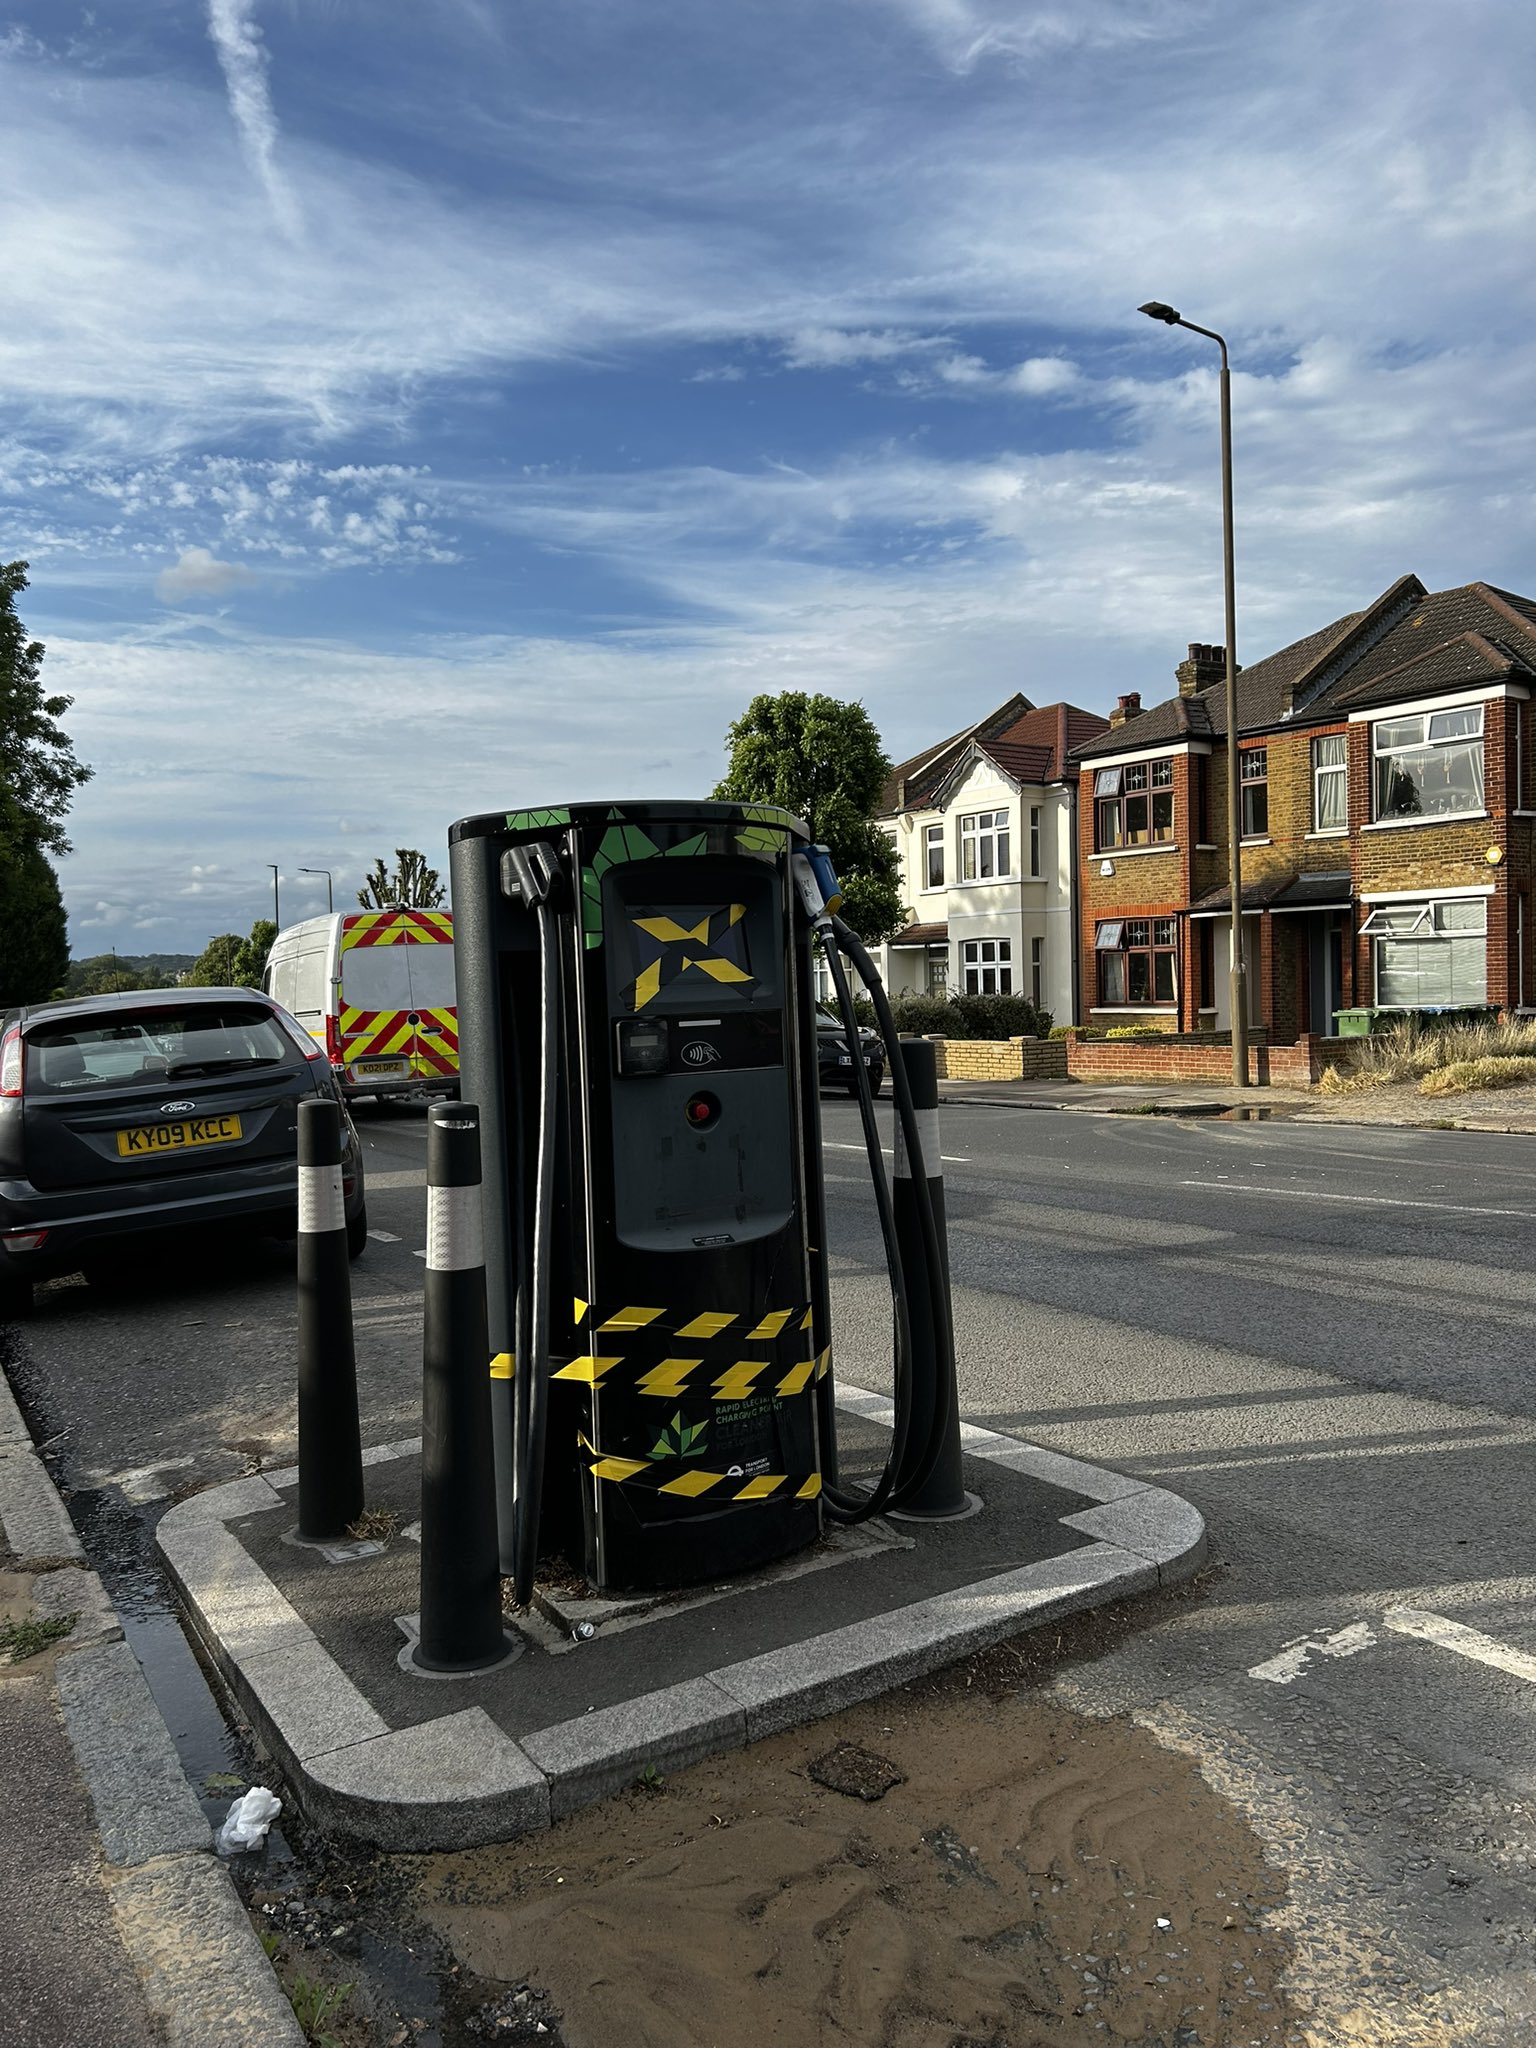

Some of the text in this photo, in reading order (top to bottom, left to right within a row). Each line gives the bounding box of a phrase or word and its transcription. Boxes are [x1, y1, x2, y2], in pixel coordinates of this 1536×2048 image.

[127, 1117, 232, 1150] KY09 KCC
[715, 1402, 740, 1415] RAPID
[715, 1401, 783, 1424] CHARGING POINT
[745, 1457, 768, 1468] TRANSPORT
[754, 1462, 770, 1471] LONDON
